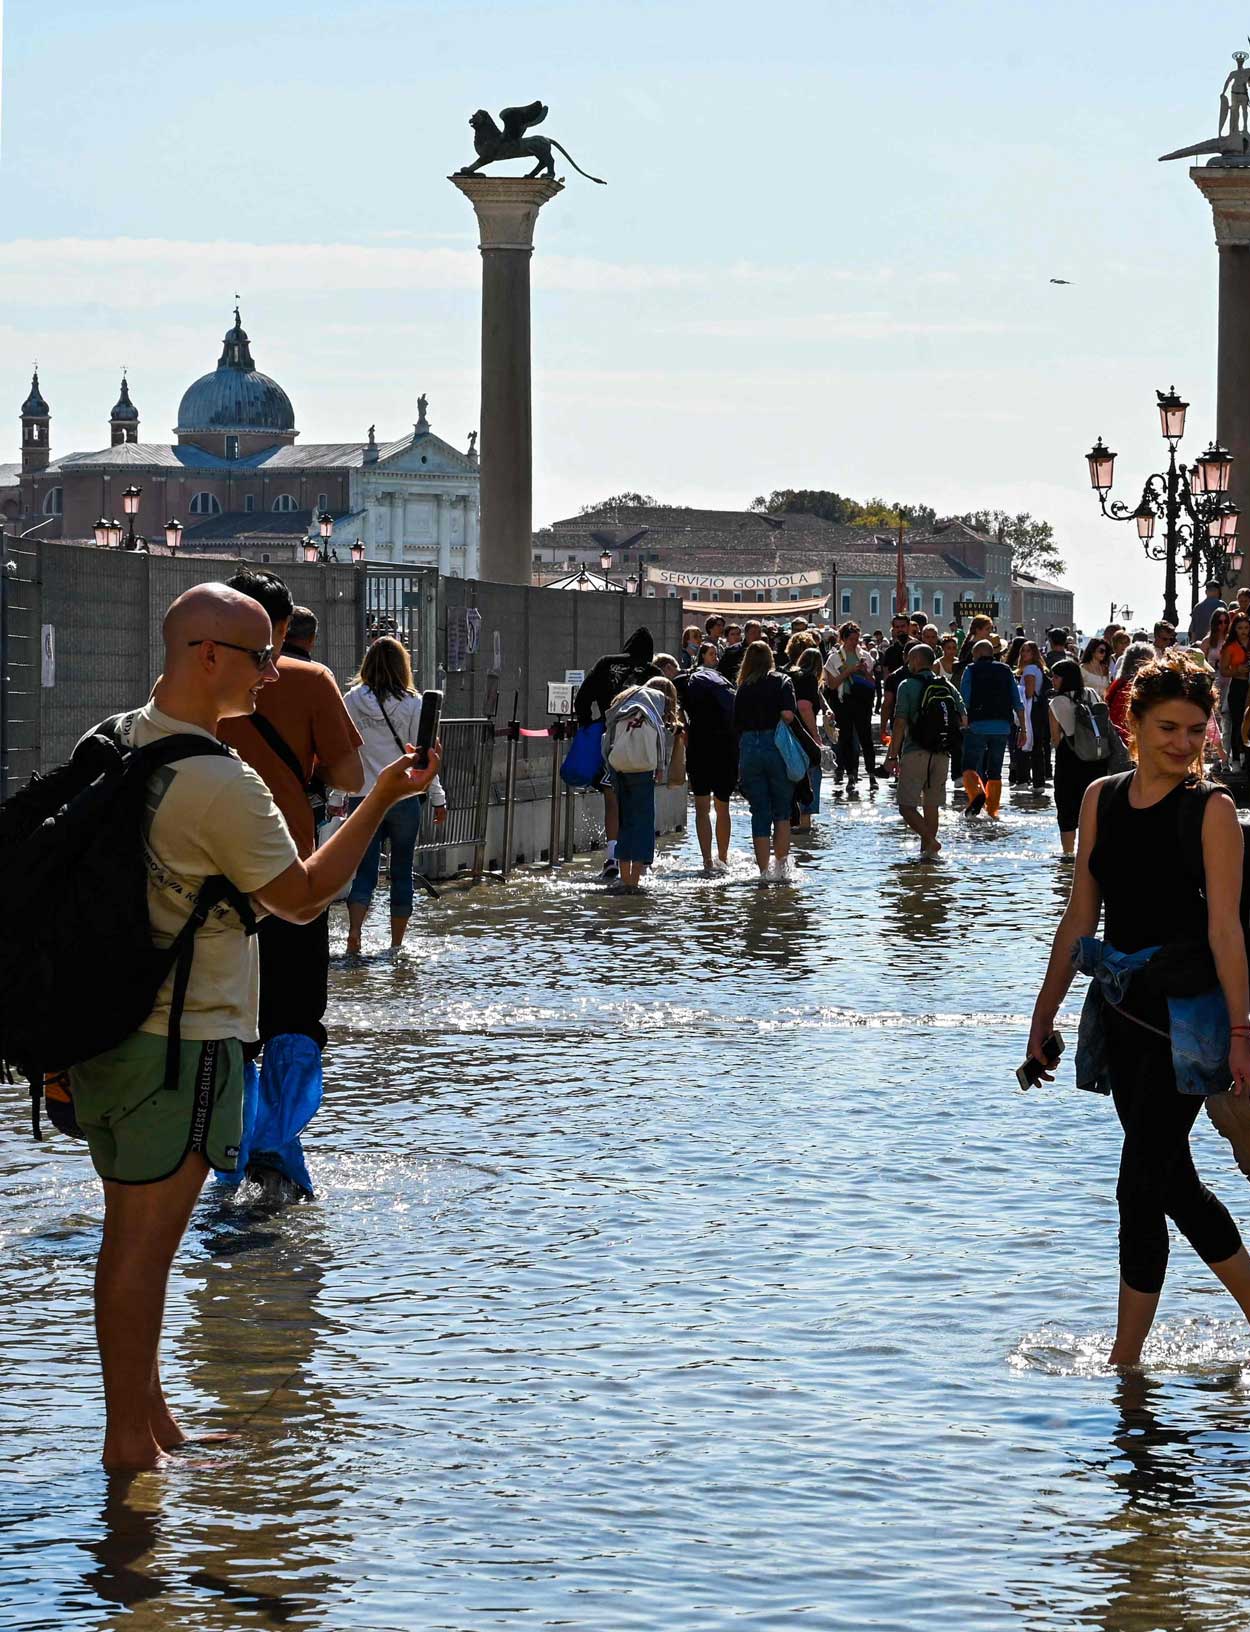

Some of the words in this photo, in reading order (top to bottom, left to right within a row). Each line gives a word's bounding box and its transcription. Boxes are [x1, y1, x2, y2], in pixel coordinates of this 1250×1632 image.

[660, 571, 724, 588] SERVIZIO
[733, 574, 808, 588] GONDOLA
[185, 892, 229, 918] KUOTA
